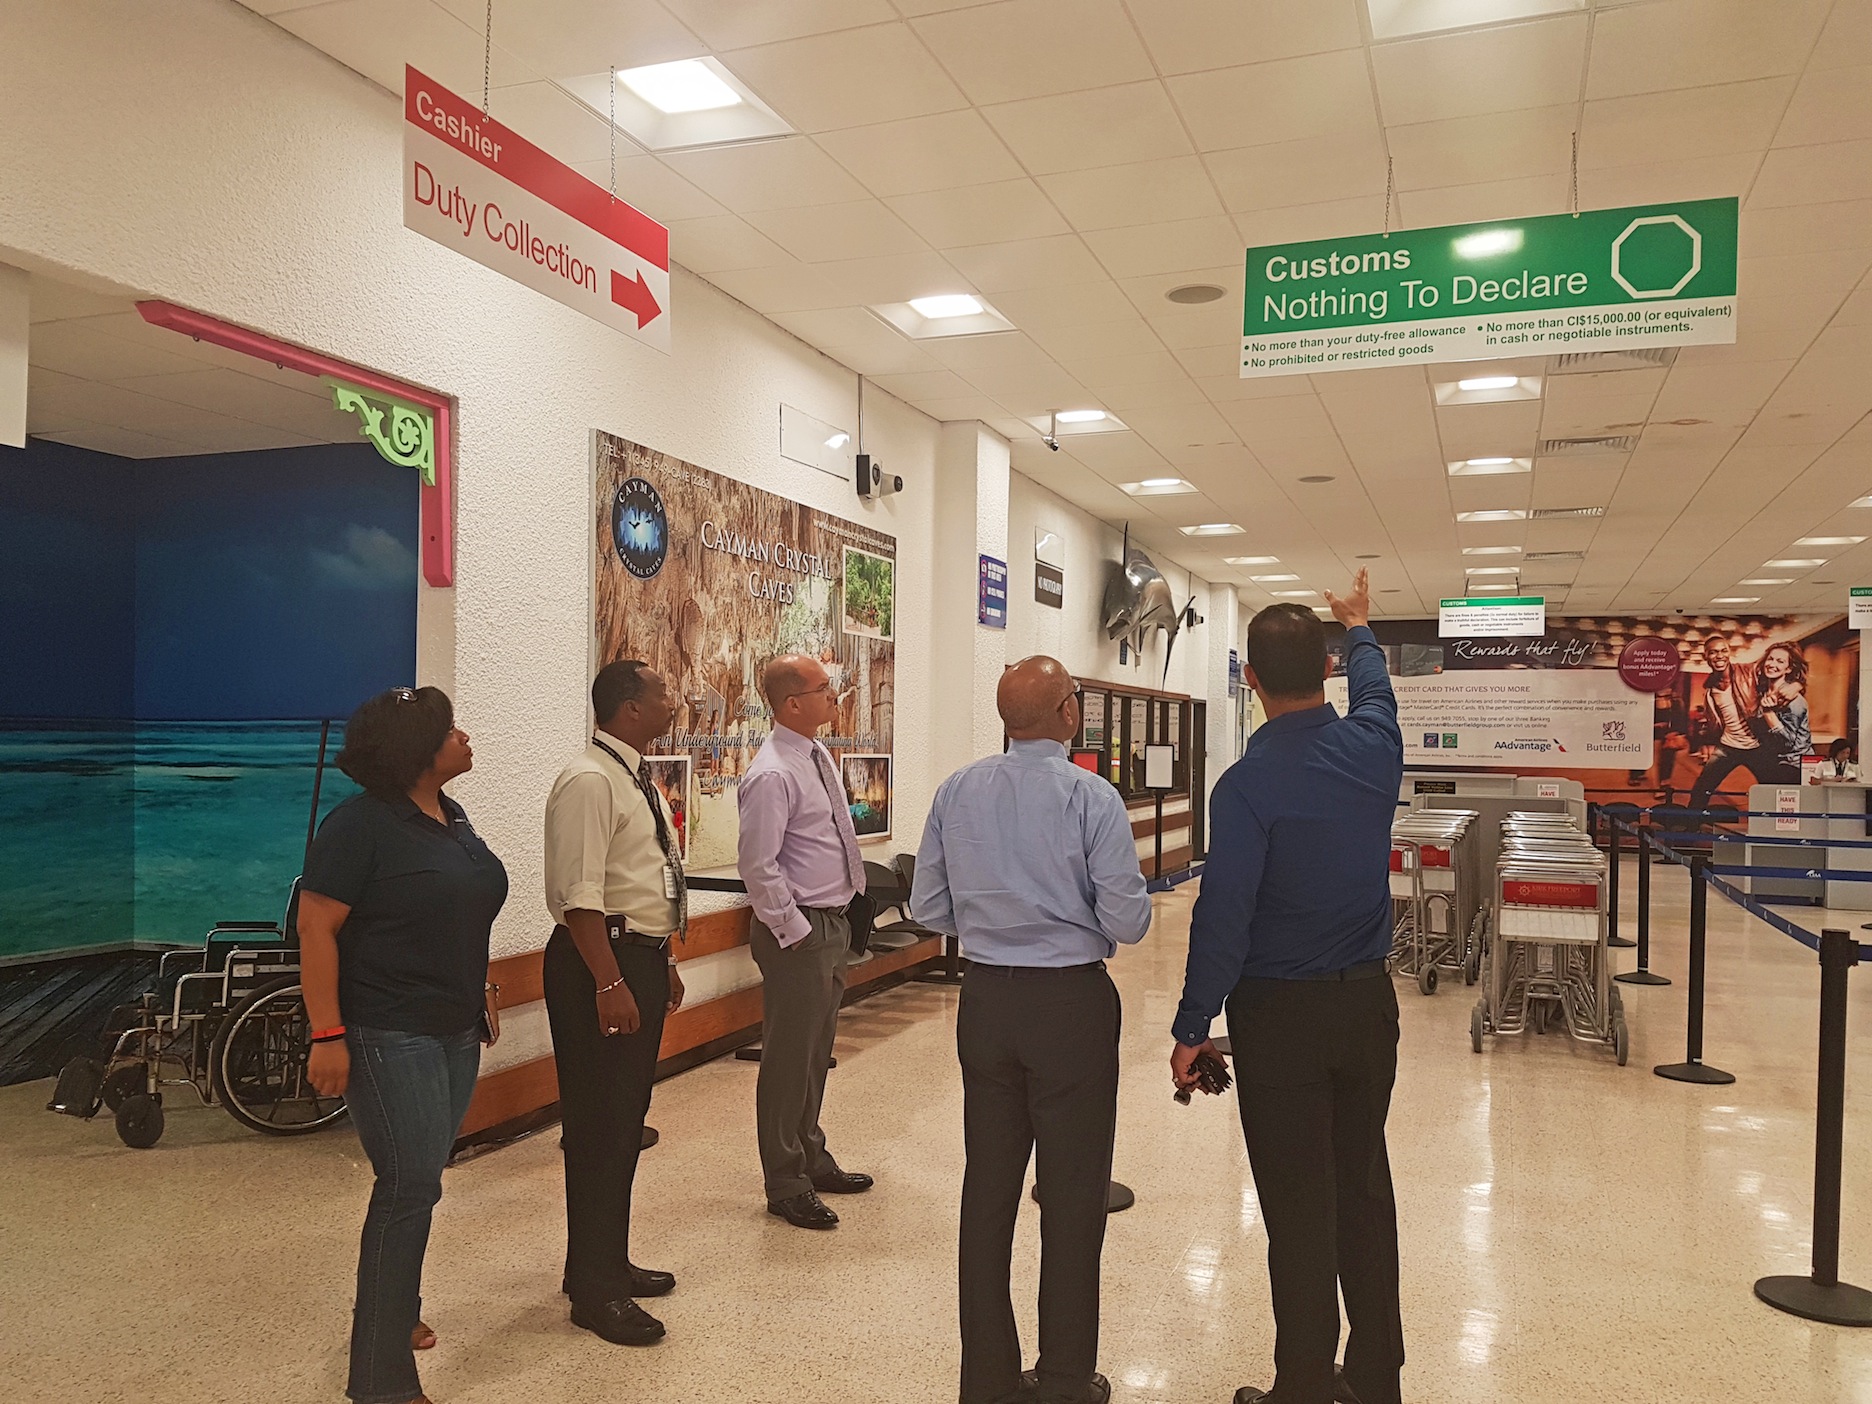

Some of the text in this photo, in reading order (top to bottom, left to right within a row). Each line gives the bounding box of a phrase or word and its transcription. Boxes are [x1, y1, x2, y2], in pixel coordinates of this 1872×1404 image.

[415, 90, 502, 163] Cashier
[414, 160, 597, 293] Duty Collection
[1265, 249, 1411, 283] Customs
[1263, 270, 1588, 322] Nothing To Declare
[1486, 321, 1694, 345] in cash or negotiable instruments.
[1487, 304, 1732, 333] No more than CI$15,000.00 (or equivalent)
[1251, 325, 1466, 352] No more than your duty-free allowance
[1251, 344, 1434, 368] No prohibited or restricted goods
[618, 481, 662, 513] CAYMAN
[813, 518, 895, 551] www.caymancrystalcaves.com
[620, 548, 644, 575] CRYSTAL
[701, 520, 832, 580] CAYMAN CRYSTAL
[749, 571, 793, 604] CAVES
[1451, 638, 1598, 665] Rewards that fly!
[733, 695, 761, 718] Come
[675, 726, 744, 754] Underground
[1494, 742, 1551, 752] AAdvantage
[1586, 743, 1641, 752] Butterfield
[703, 770, 742, 799] Cayma
